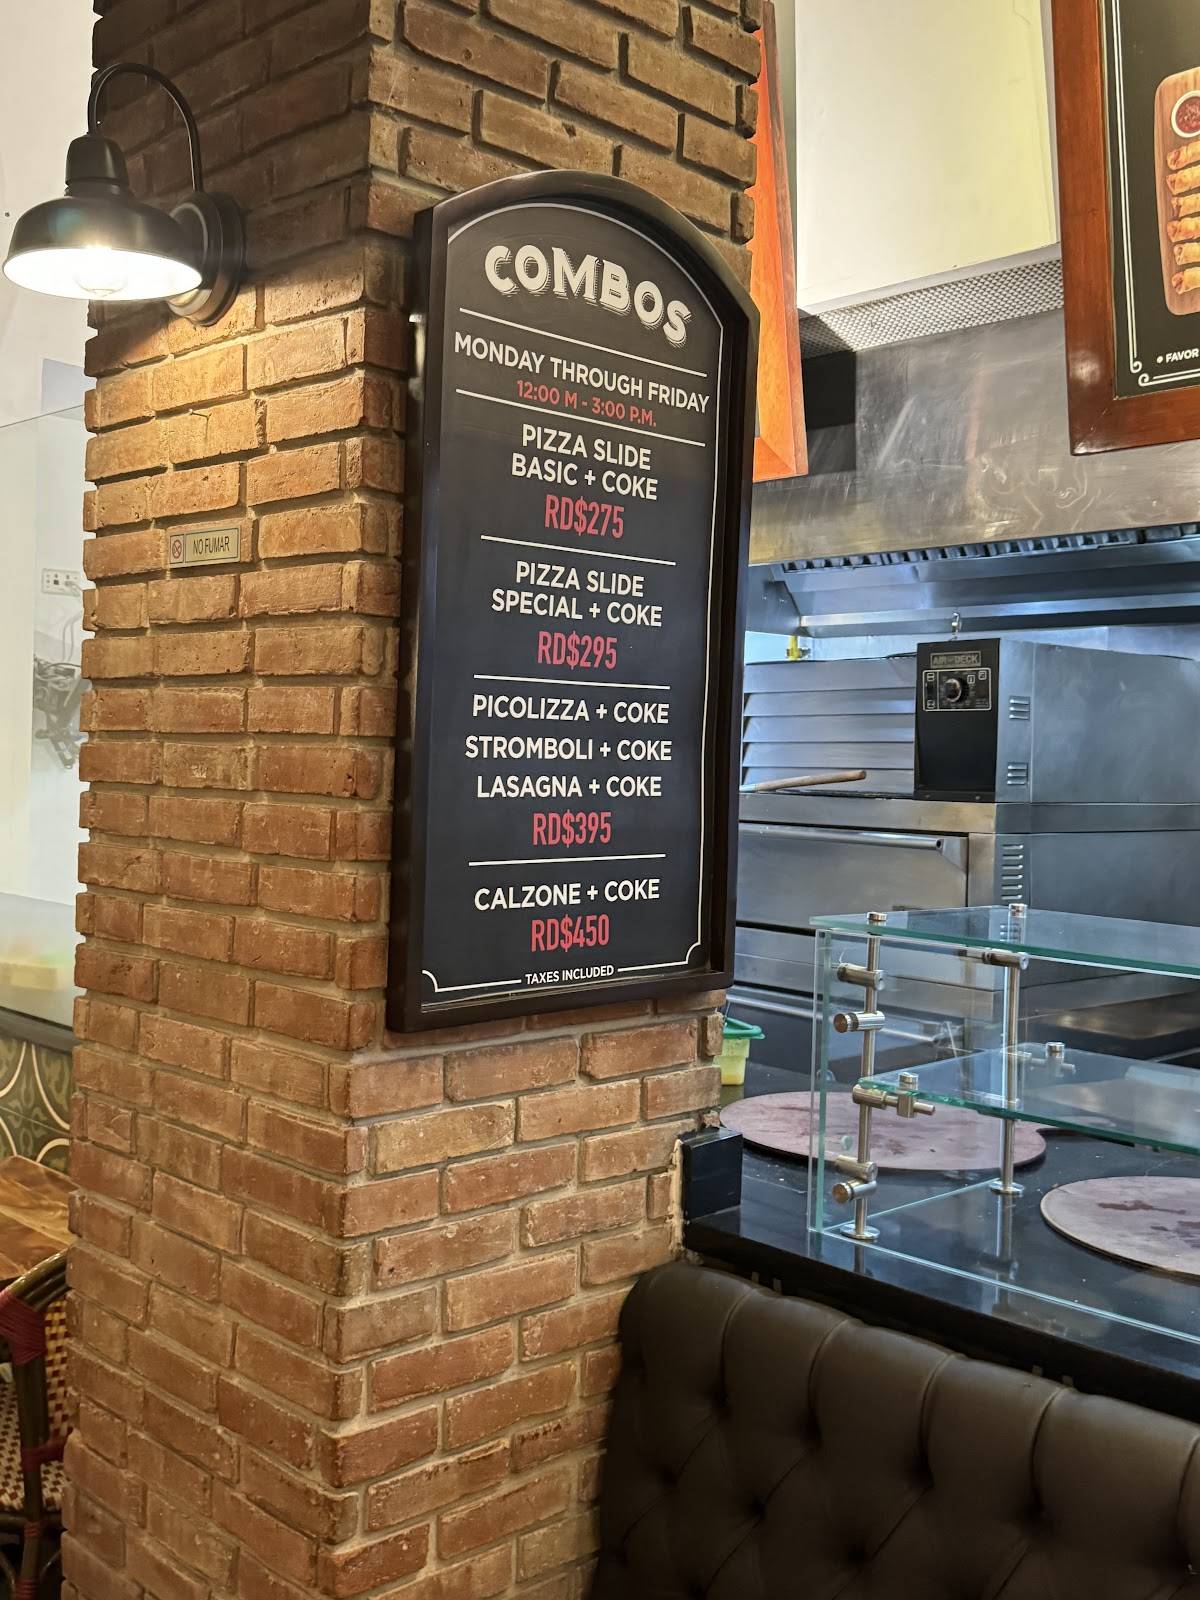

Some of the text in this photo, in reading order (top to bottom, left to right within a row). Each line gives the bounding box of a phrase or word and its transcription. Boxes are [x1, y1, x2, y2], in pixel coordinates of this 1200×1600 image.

[484, 244, 692, 348] COMBOS
[454, 331, 710, 414] MONDAY THROUGH FRIDAY
[1165, 347, 1199, 363] FAVOR
[516, 379, 560, 405] 12:00
[564, 391, 578, 410] M
[591, 396, 626, 421] 3:00
[629, 406, 657, 428] P.M.
[522, 423, 652, 471] PIZZA SLIDE
[511, 452, 659, 501] BASIC + COKE
[544, 494, 625, 539] RD$275
[193, 536, 229, 555] NO FUMAR
[515, 560, 645, 598] PIZZA SLIDE
[491, 588, 663, 627] SPECIAL + COKE
[537, 630, 618, 670] RD$295
[472, 694, 670, 724] PICOLIZZA + COKE
[464, 735, 673, 761] STROMBOLI + COKE
[477, 775, 662, 798] LASAGNA + COKE
[532, 809, 612, 848] RD$395
[474, 878, 661, 911] CALZONE + COKE
[530, 914, 611, 953] RD$450
[525, 964, 615, 985] TAXES INCLUDED
